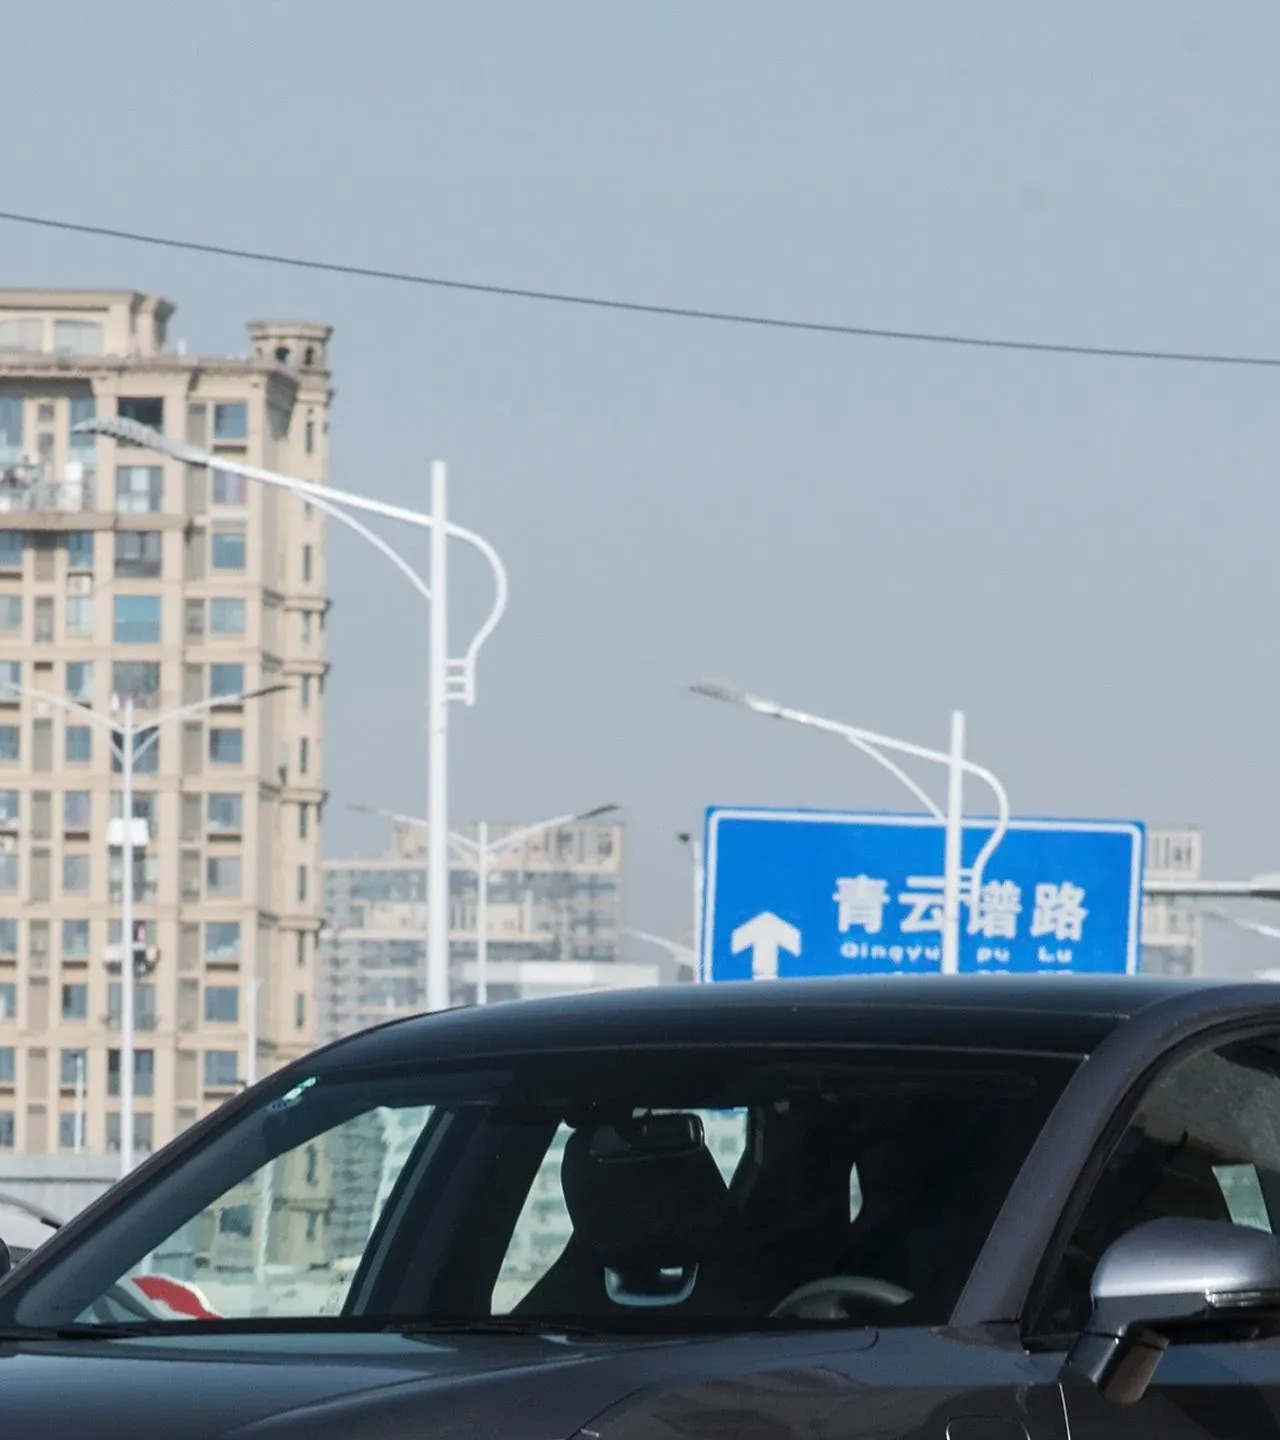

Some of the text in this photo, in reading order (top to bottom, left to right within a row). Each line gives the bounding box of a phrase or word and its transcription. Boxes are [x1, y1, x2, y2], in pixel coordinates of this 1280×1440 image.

[832, 874, 1089, 942] 青云谱路
[839, 941, 943, 963] Qingyu
[1037, 944, 1073, 964] Lu
